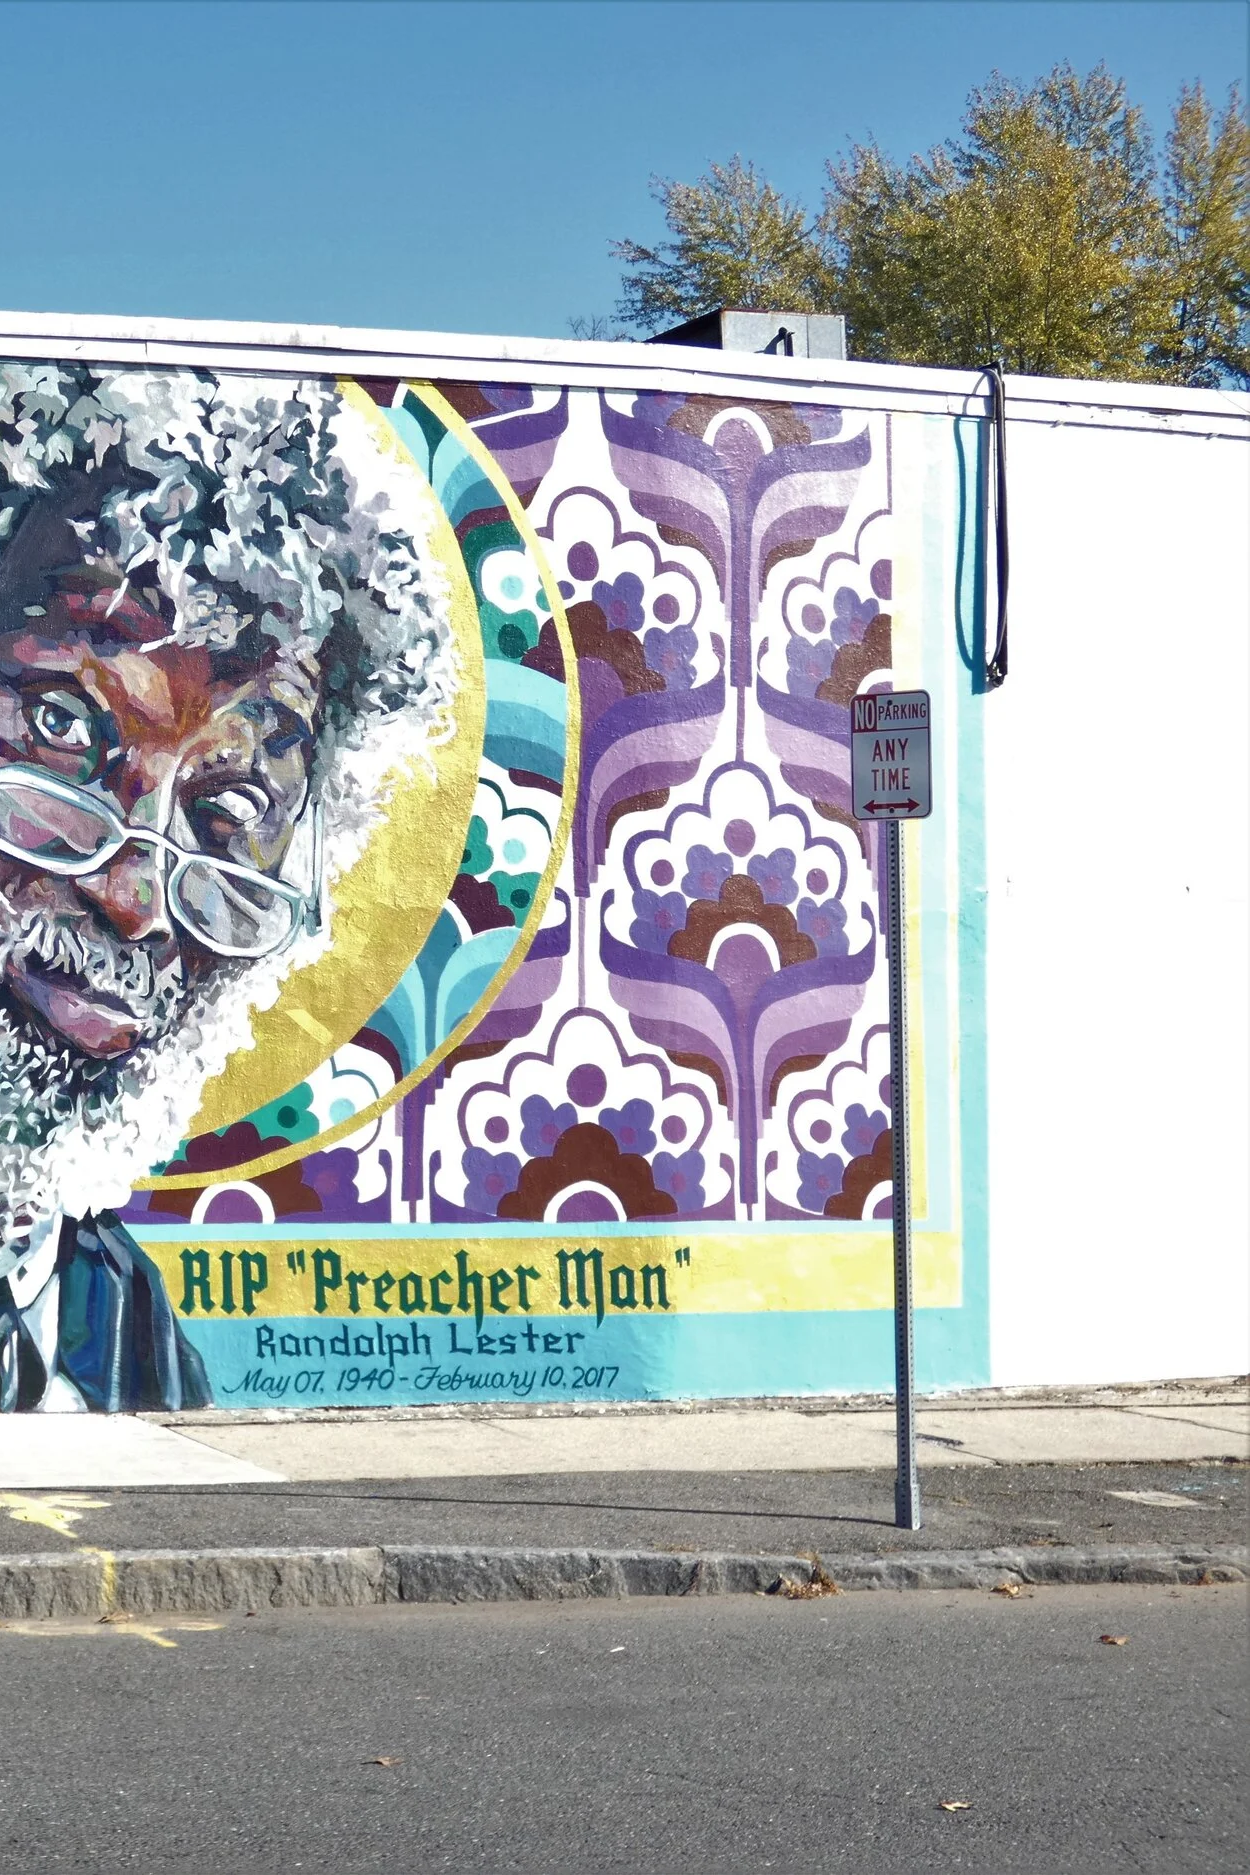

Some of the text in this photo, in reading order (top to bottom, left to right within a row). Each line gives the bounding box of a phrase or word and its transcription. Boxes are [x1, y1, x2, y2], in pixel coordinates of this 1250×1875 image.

[854, 698, 927, 730] NO PARKING
[872, 737, 909, 762] ANY
[871, 767, 911, 792] TIME
[179, 1248, 269, 1317] RIP
[255, 1319, 586, 1368] Randolph Lester
[222, 1367, 291, 1399] May
[294, 1370, 324, 1394] 07,
[337, 1366, 396, 1392] 1940
[414, 1364, 537, 1397] February
[572, 1366, 620, 1389] 2017
